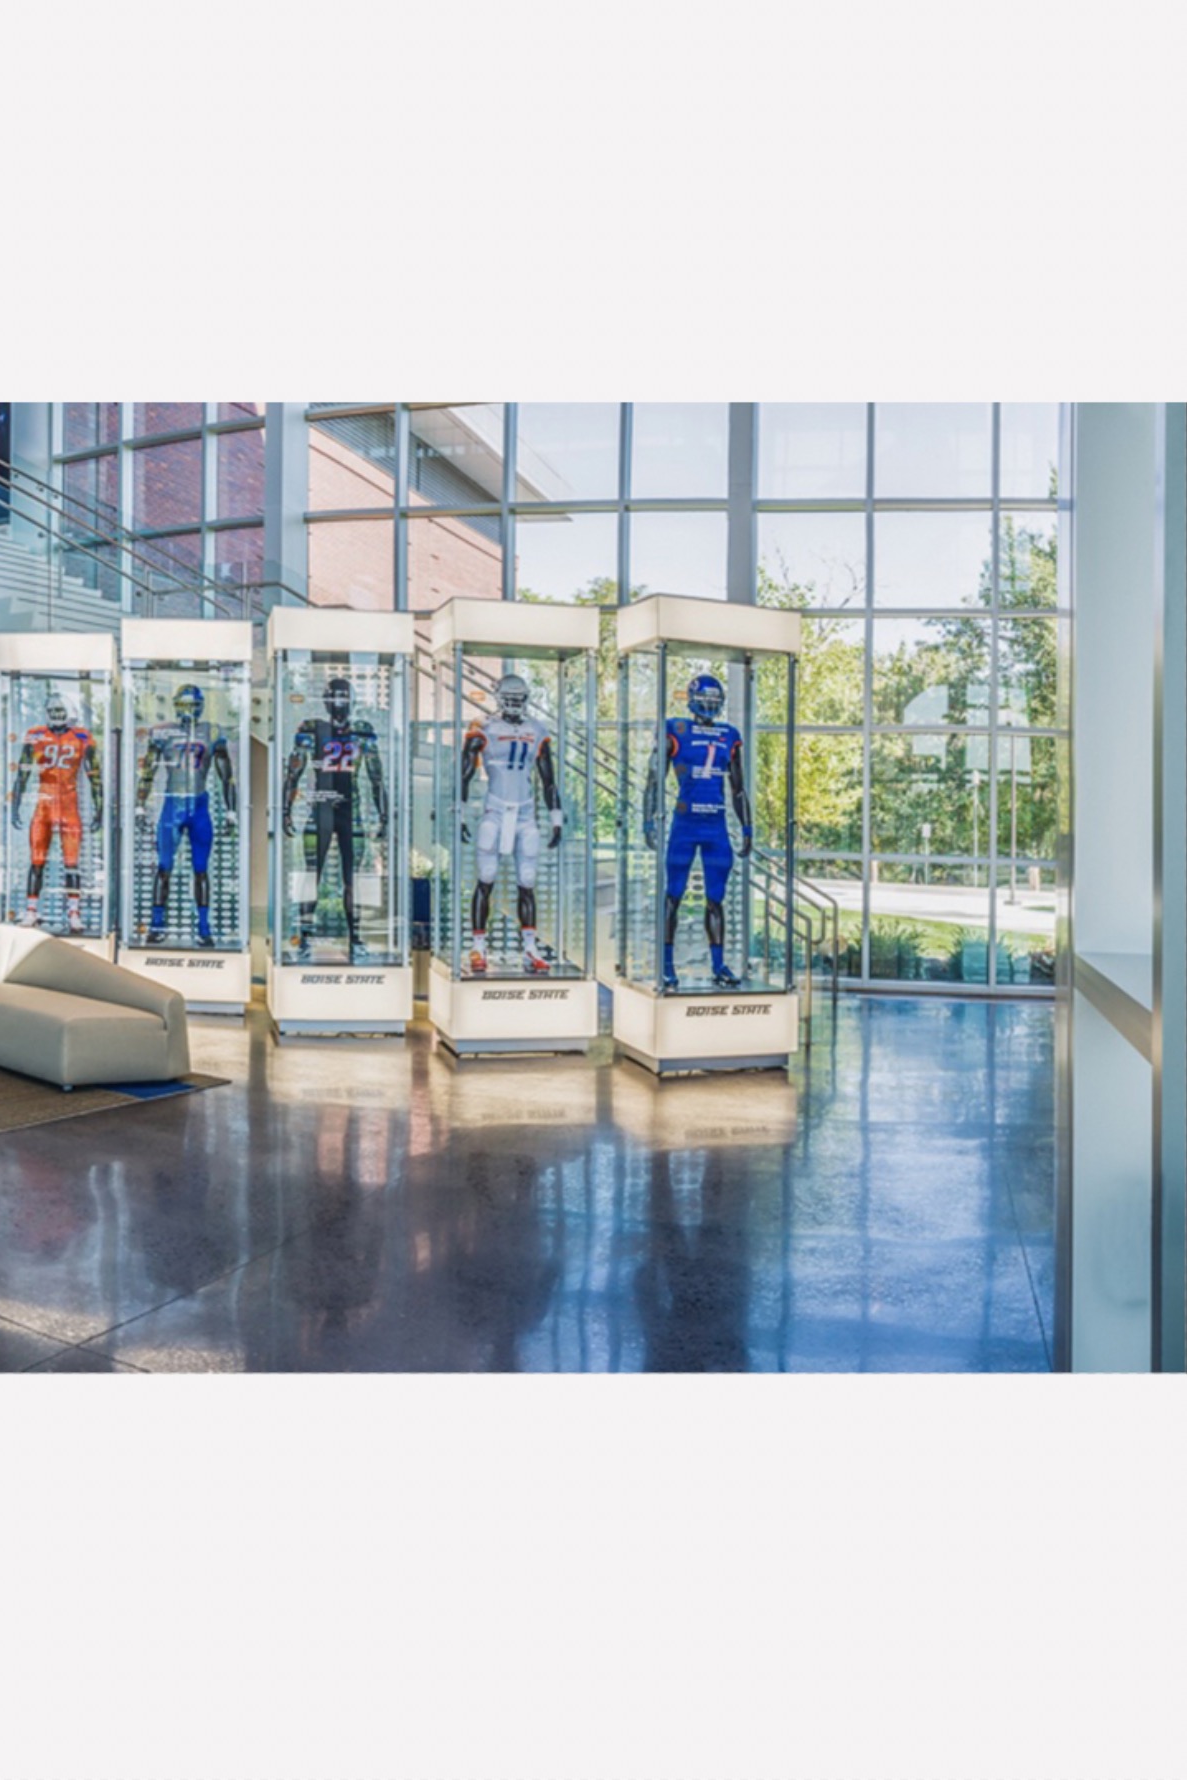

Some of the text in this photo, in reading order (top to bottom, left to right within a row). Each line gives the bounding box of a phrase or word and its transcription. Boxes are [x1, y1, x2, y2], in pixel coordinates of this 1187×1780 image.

[44, 744, 75, 769] 92
[323, 741, 361, 772] 22
[507, 740, 528, 770] 11
[145, 957, 225, 969] BOISE STATE
[301, 974, 385, 984] BOISE STATE
[481, 989, 570, 1000] BOISE STATE
[685, 1004, 772, 1017] BOISE STATE
